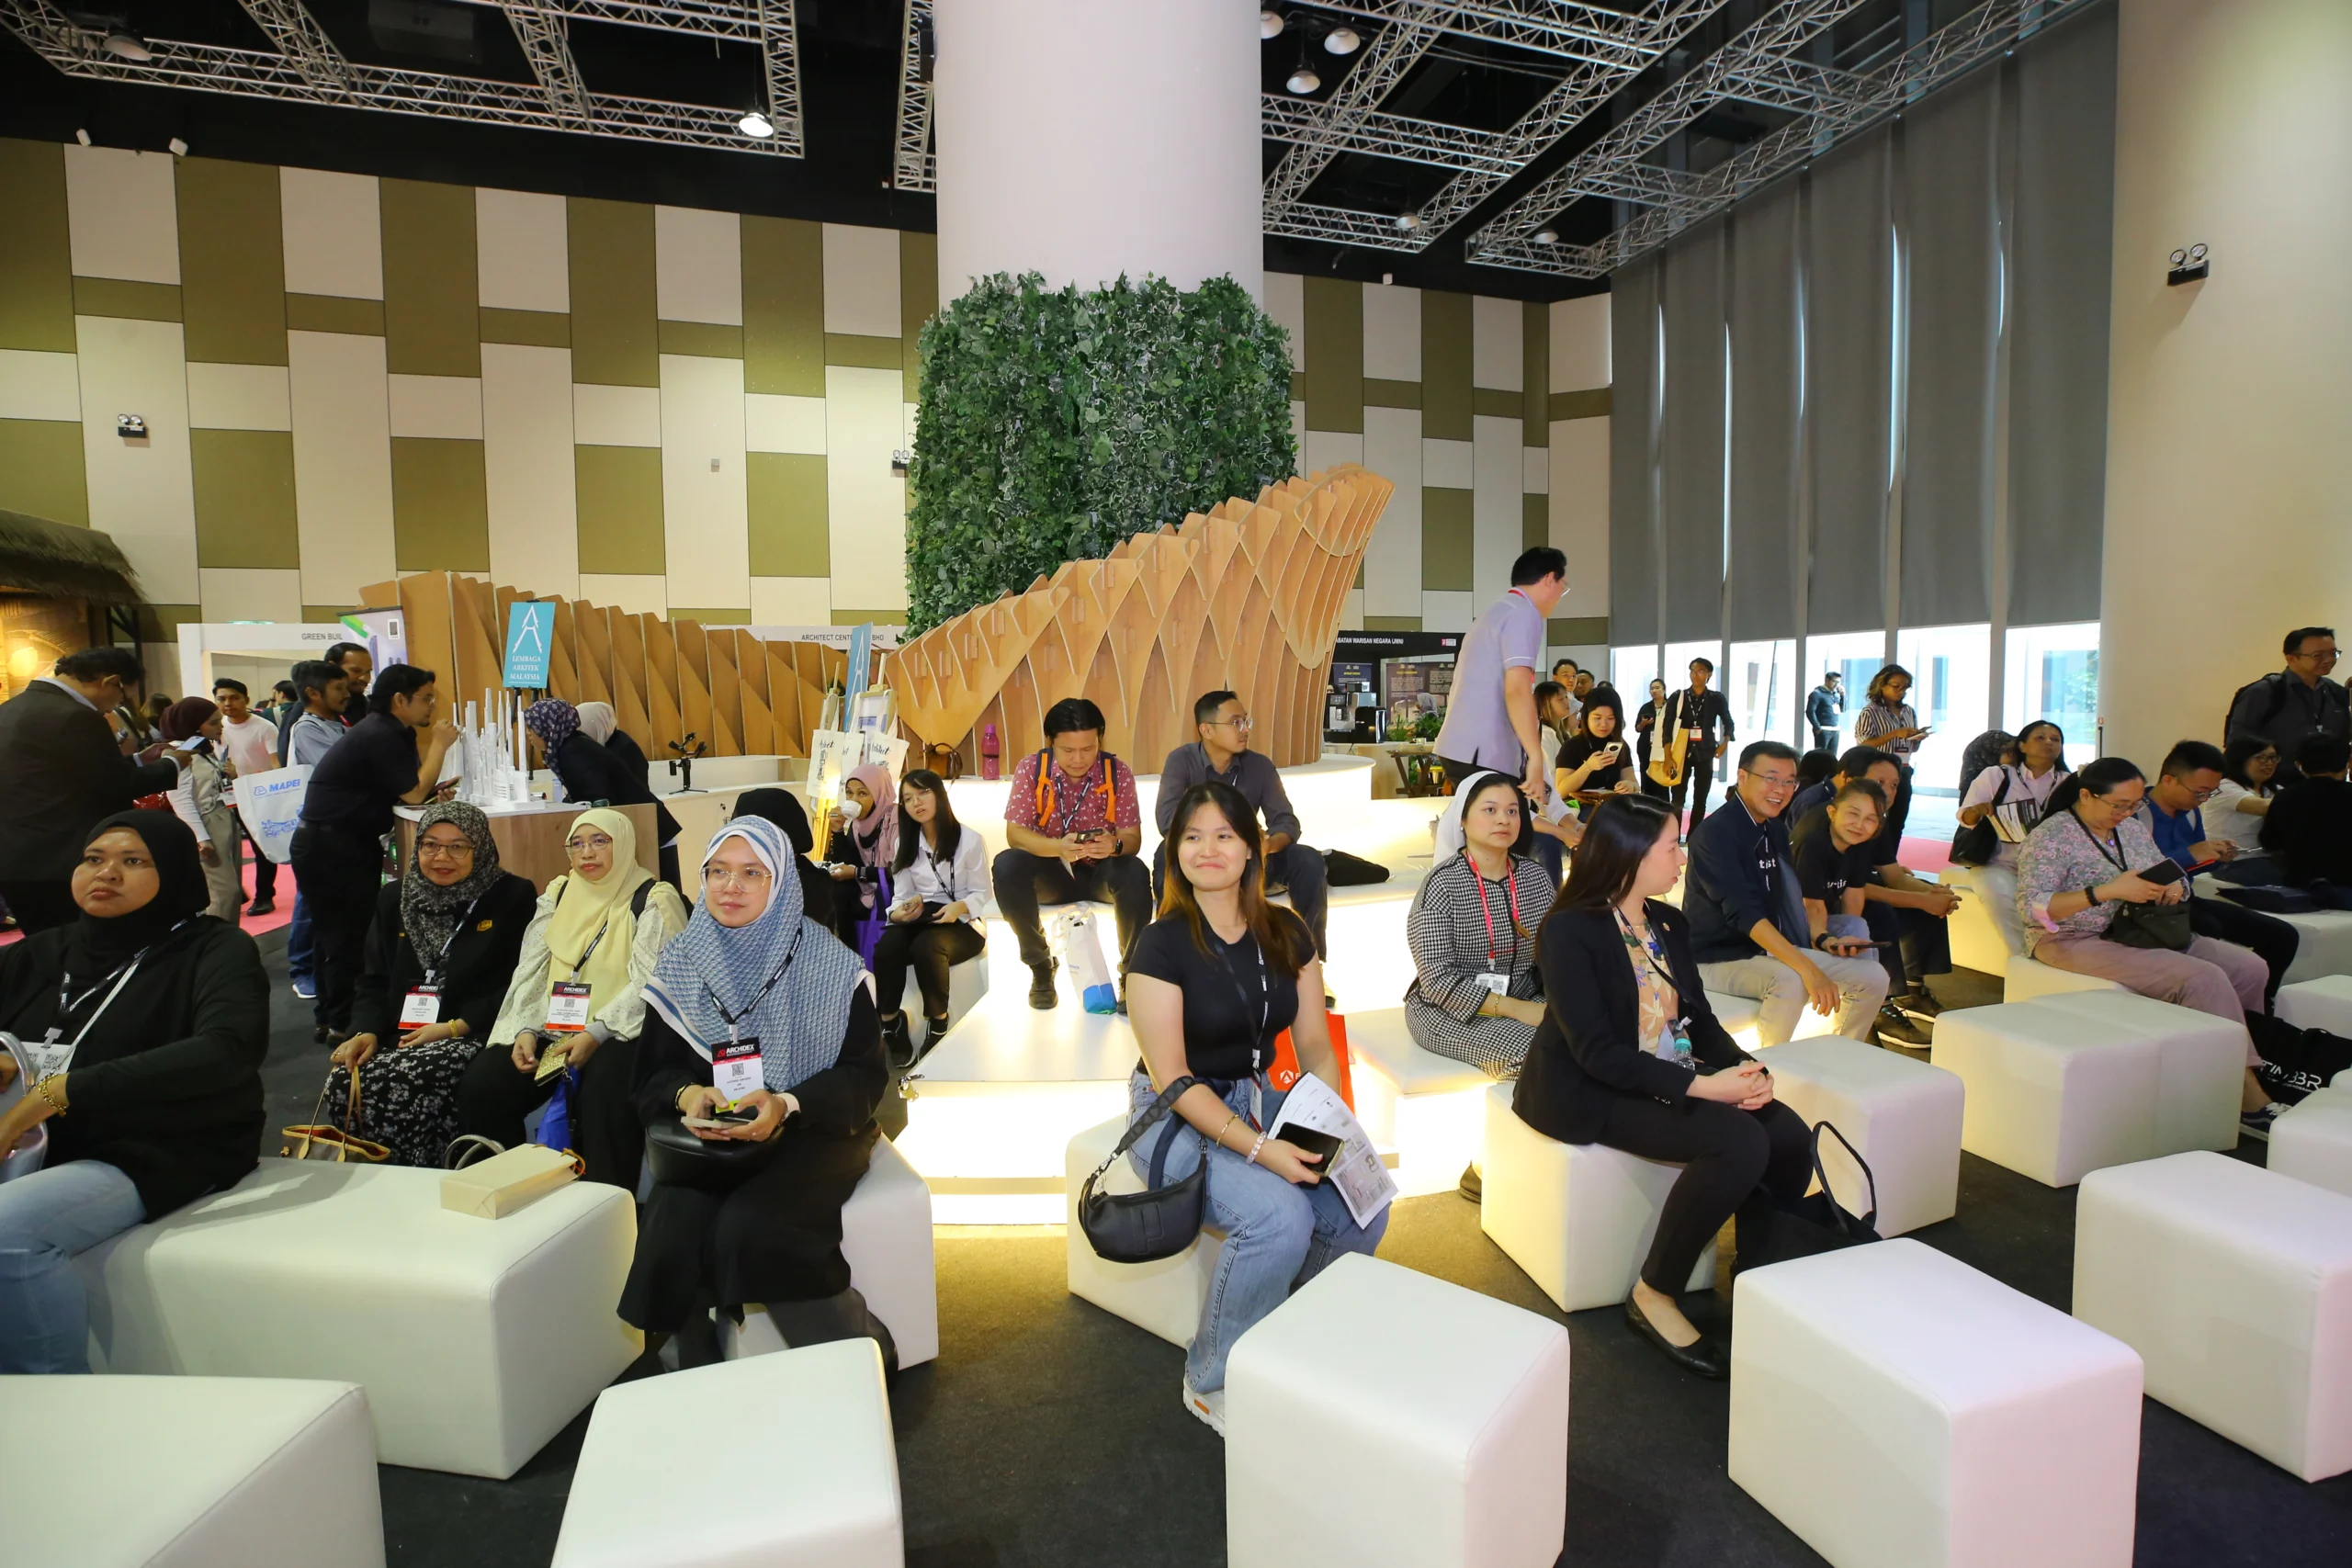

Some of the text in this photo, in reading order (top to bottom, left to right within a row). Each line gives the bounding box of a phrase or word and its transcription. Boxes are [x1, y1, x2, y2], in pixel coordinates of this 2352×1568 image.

[510, 672, 540, 681] MALAYSIA
[269, 778, 300, 792] MAPEI
[726, 1044, 754, 1055] ARCHIDEX
